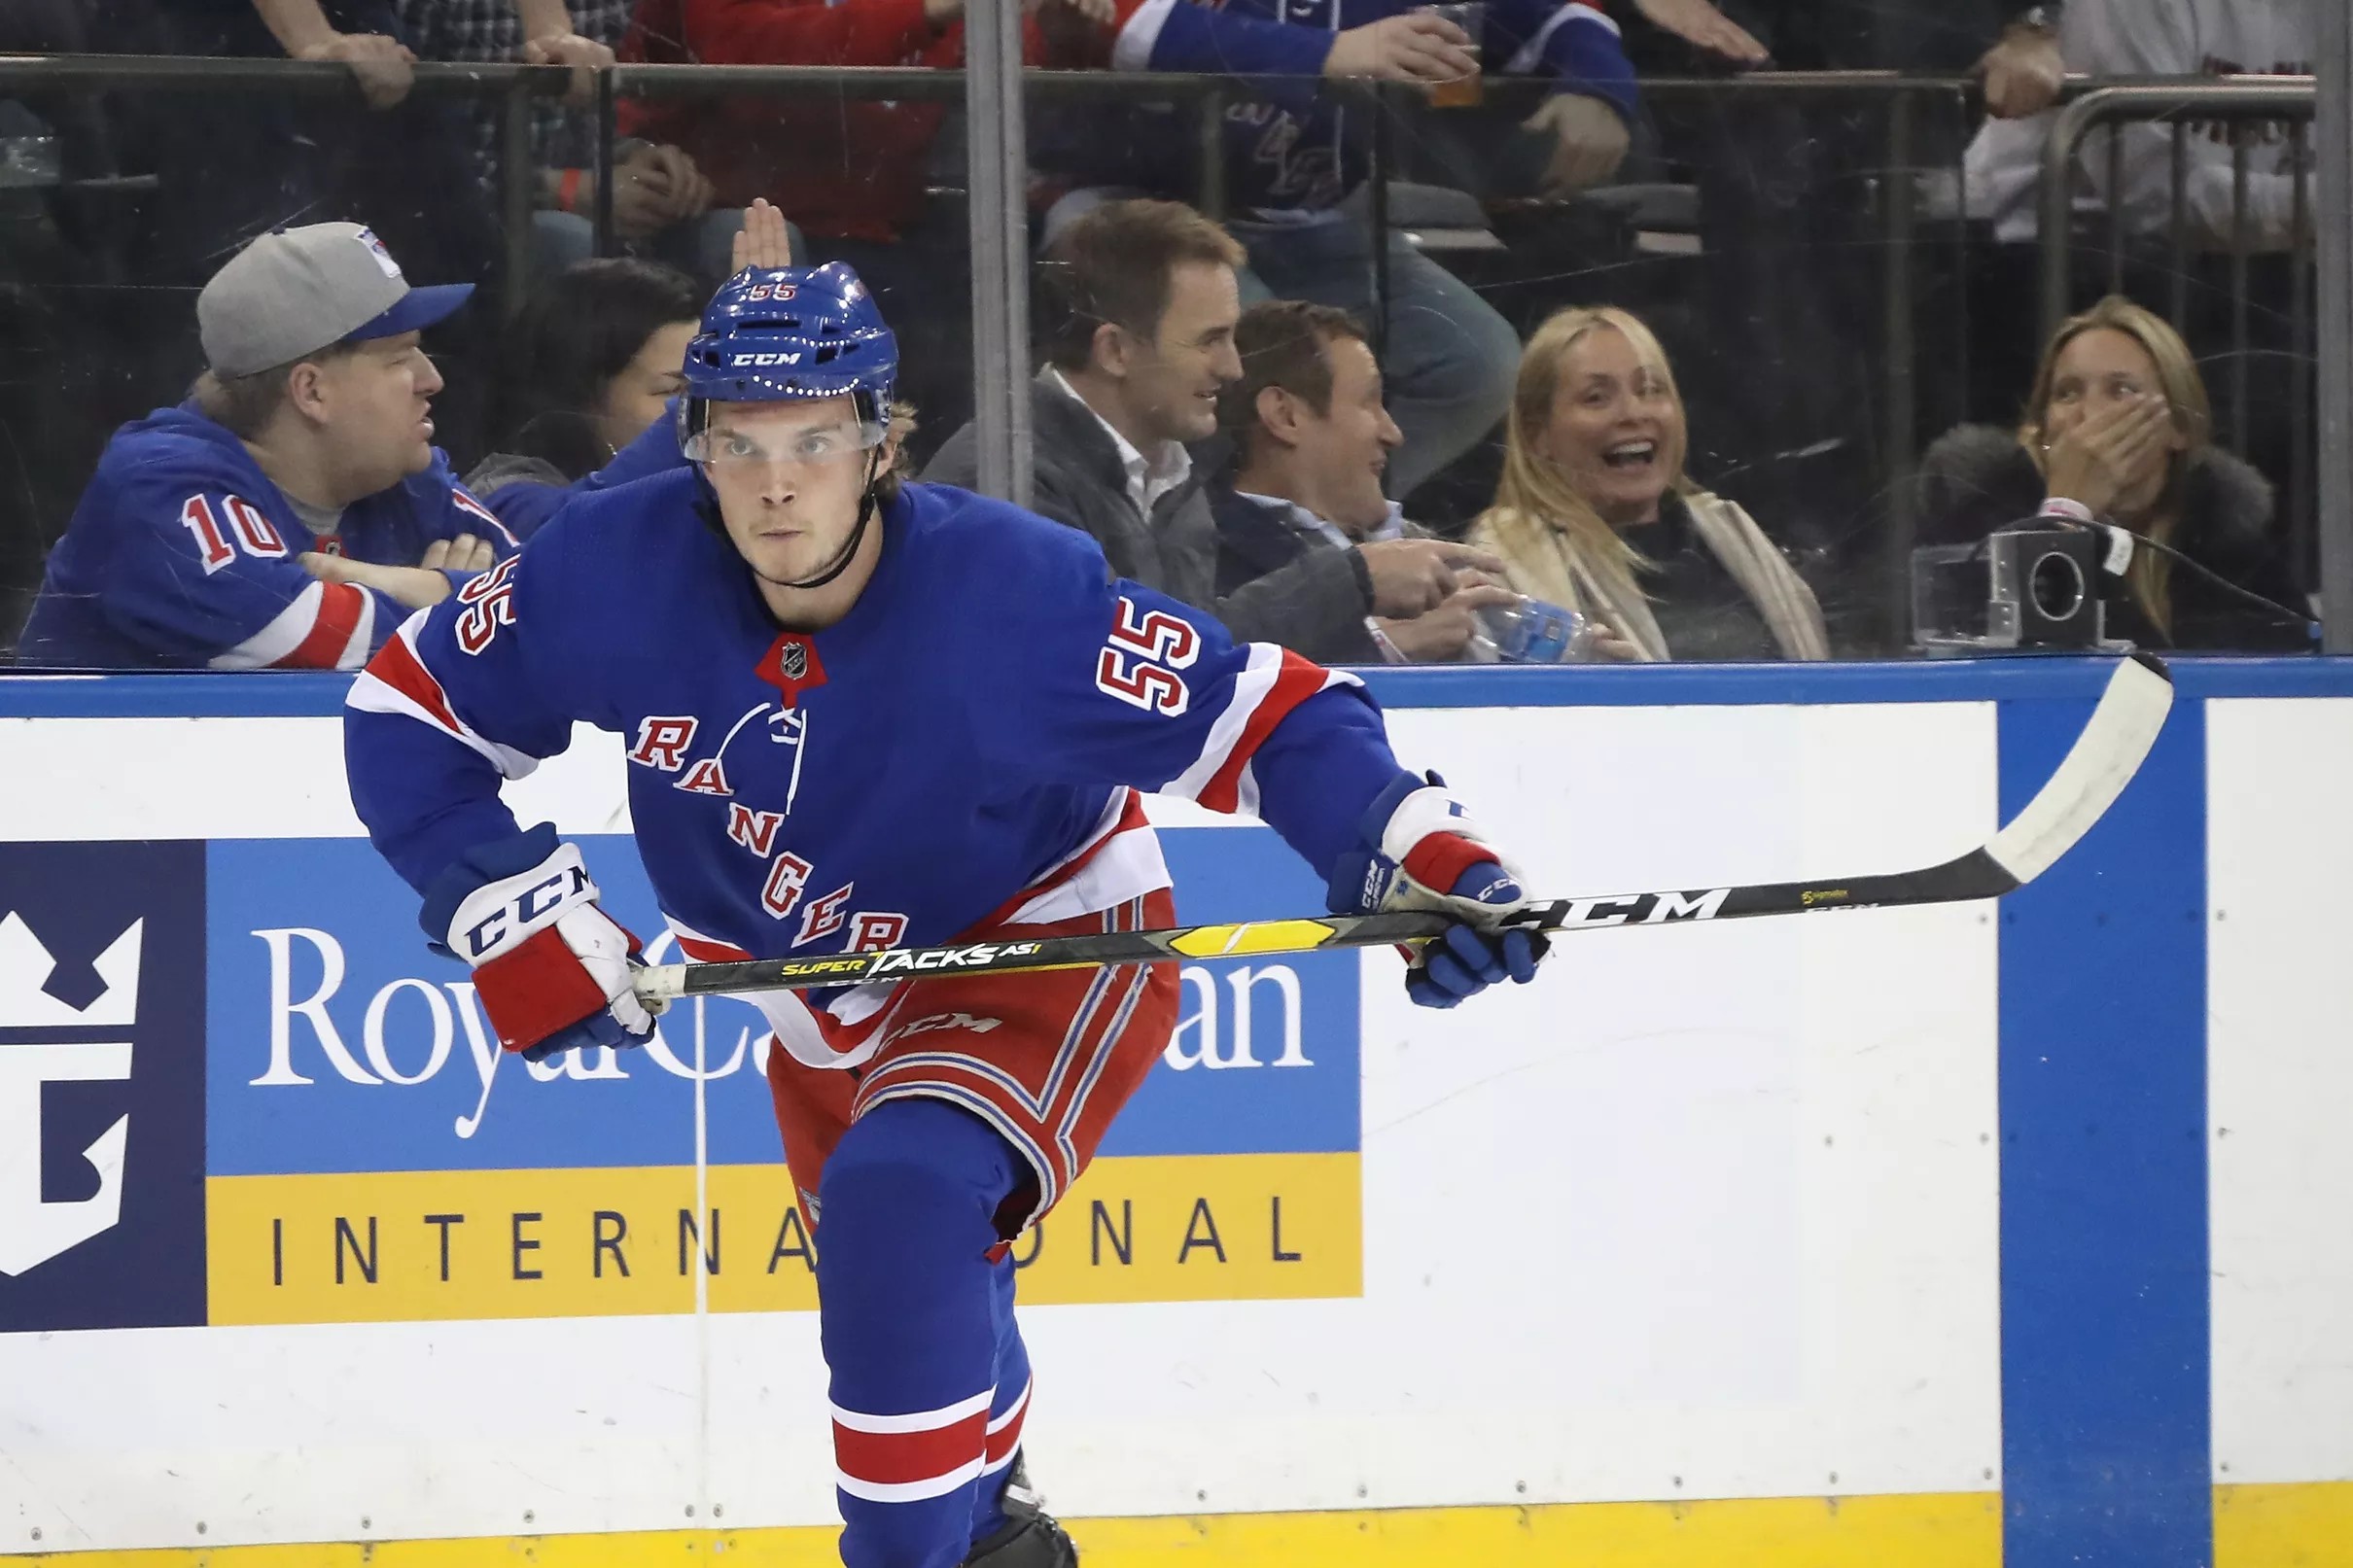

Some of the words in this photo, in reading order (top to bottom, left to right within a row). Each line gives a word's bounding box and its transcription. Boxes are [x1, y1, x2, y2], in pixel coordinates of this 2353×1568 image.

[749, 284, 797, 301] 55
[732, 353, 801, 366] CCM
[182, 493, 289, 575] 10
[1096, 596, 1202, 718] 55
[1361, 858, 1379, 909] CCM
[781, 959, 867, 976] SUPER
[866, 943, 1001, 978] TACKS
[249, 926, 630, 1139] Roy
[272, 1196, 1303, 1287] INTERNANAL
